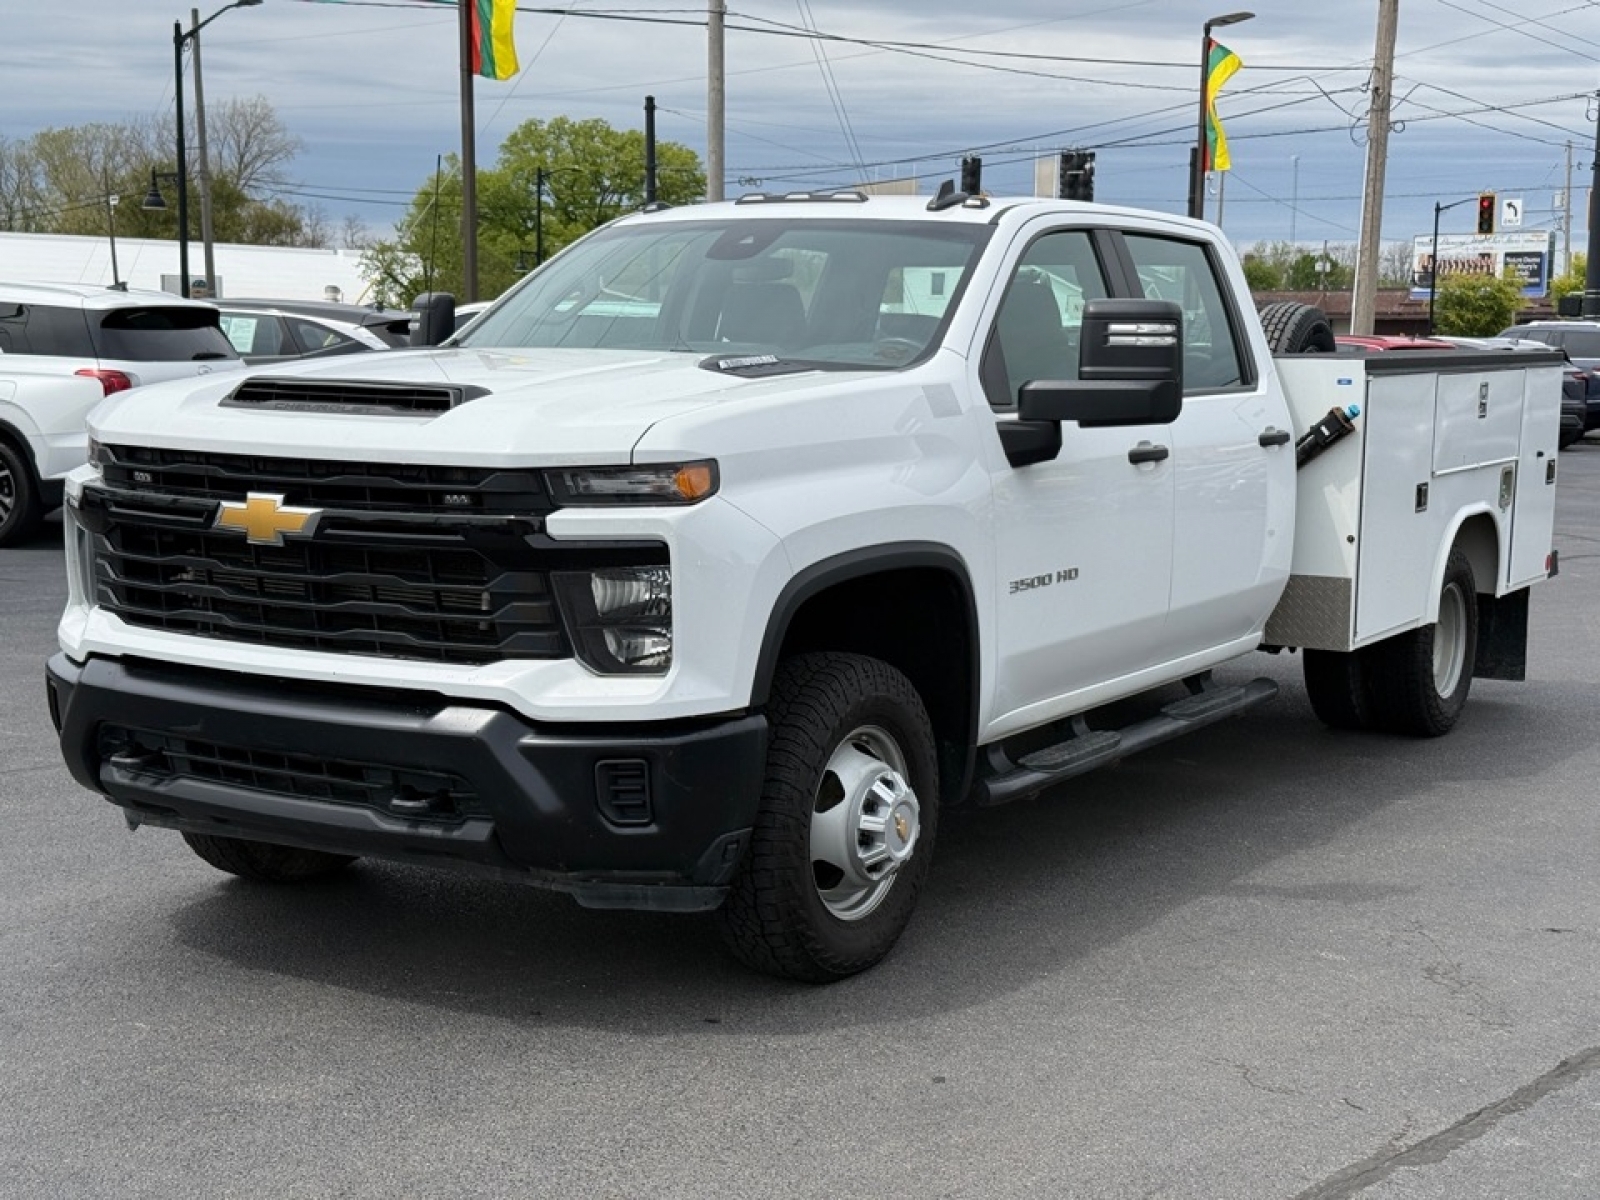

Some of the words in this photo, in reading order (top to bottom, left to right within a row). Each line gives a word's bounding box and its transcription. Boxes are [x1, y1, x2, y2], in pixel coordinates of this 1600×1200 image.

[274, 402, 377, 415] CHEVROLET
[1008, 572, 1053, 595] 3500
[1056, 567, 1079, 584] HD
